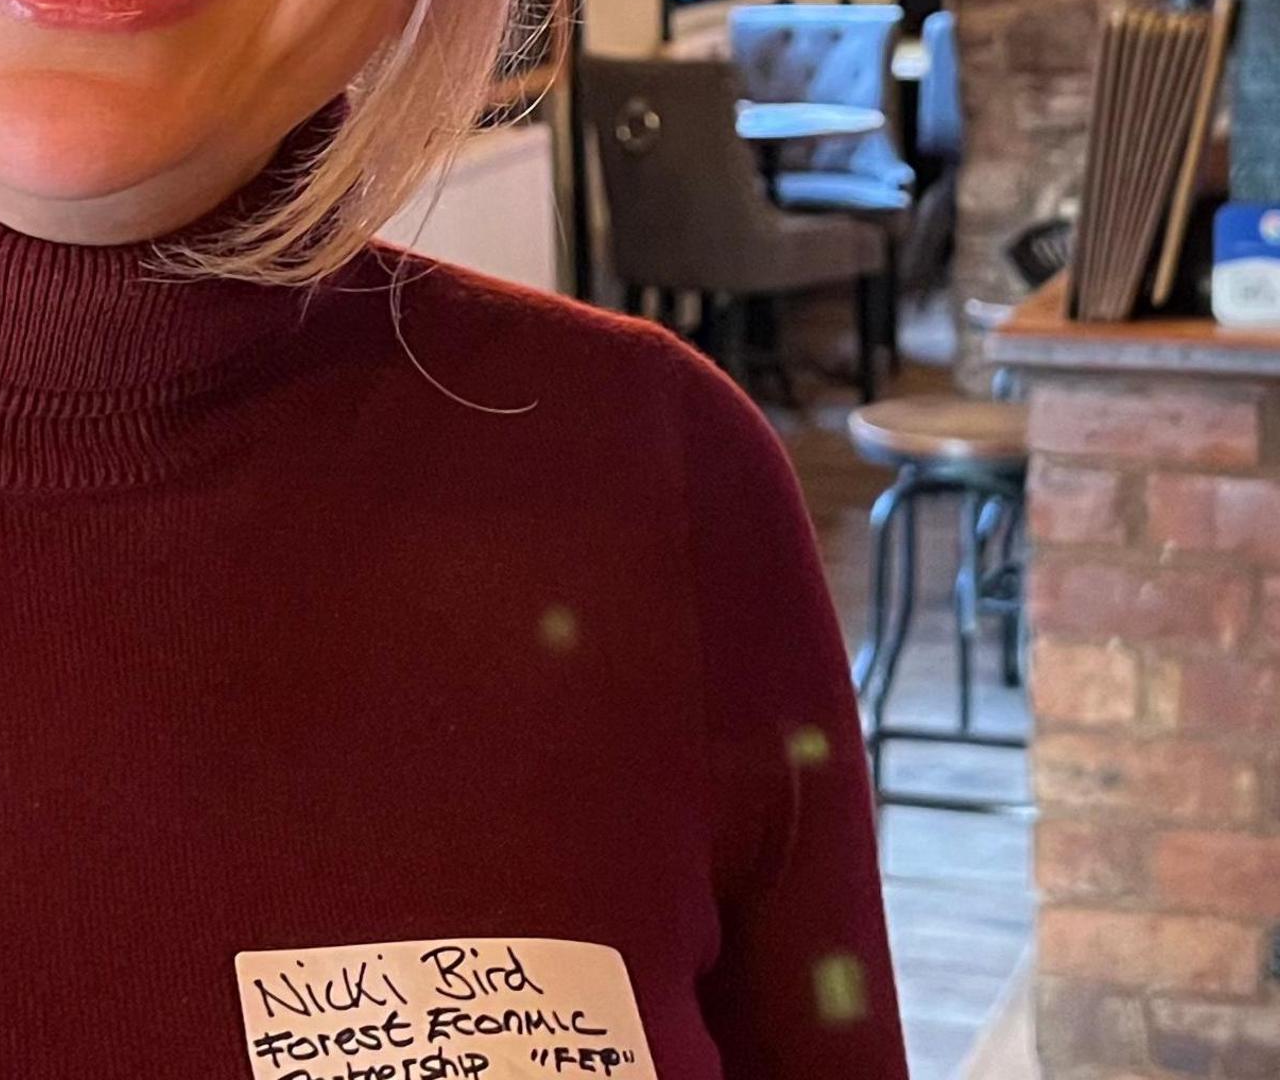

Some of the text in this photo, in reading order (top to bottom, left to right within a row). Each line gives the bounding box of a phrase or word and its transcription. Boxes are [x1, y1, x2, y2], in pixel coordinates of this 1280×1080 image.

[253, 946, 544, 1018] Nicki Bird
[253, 1010, 414, 1069] Forest
